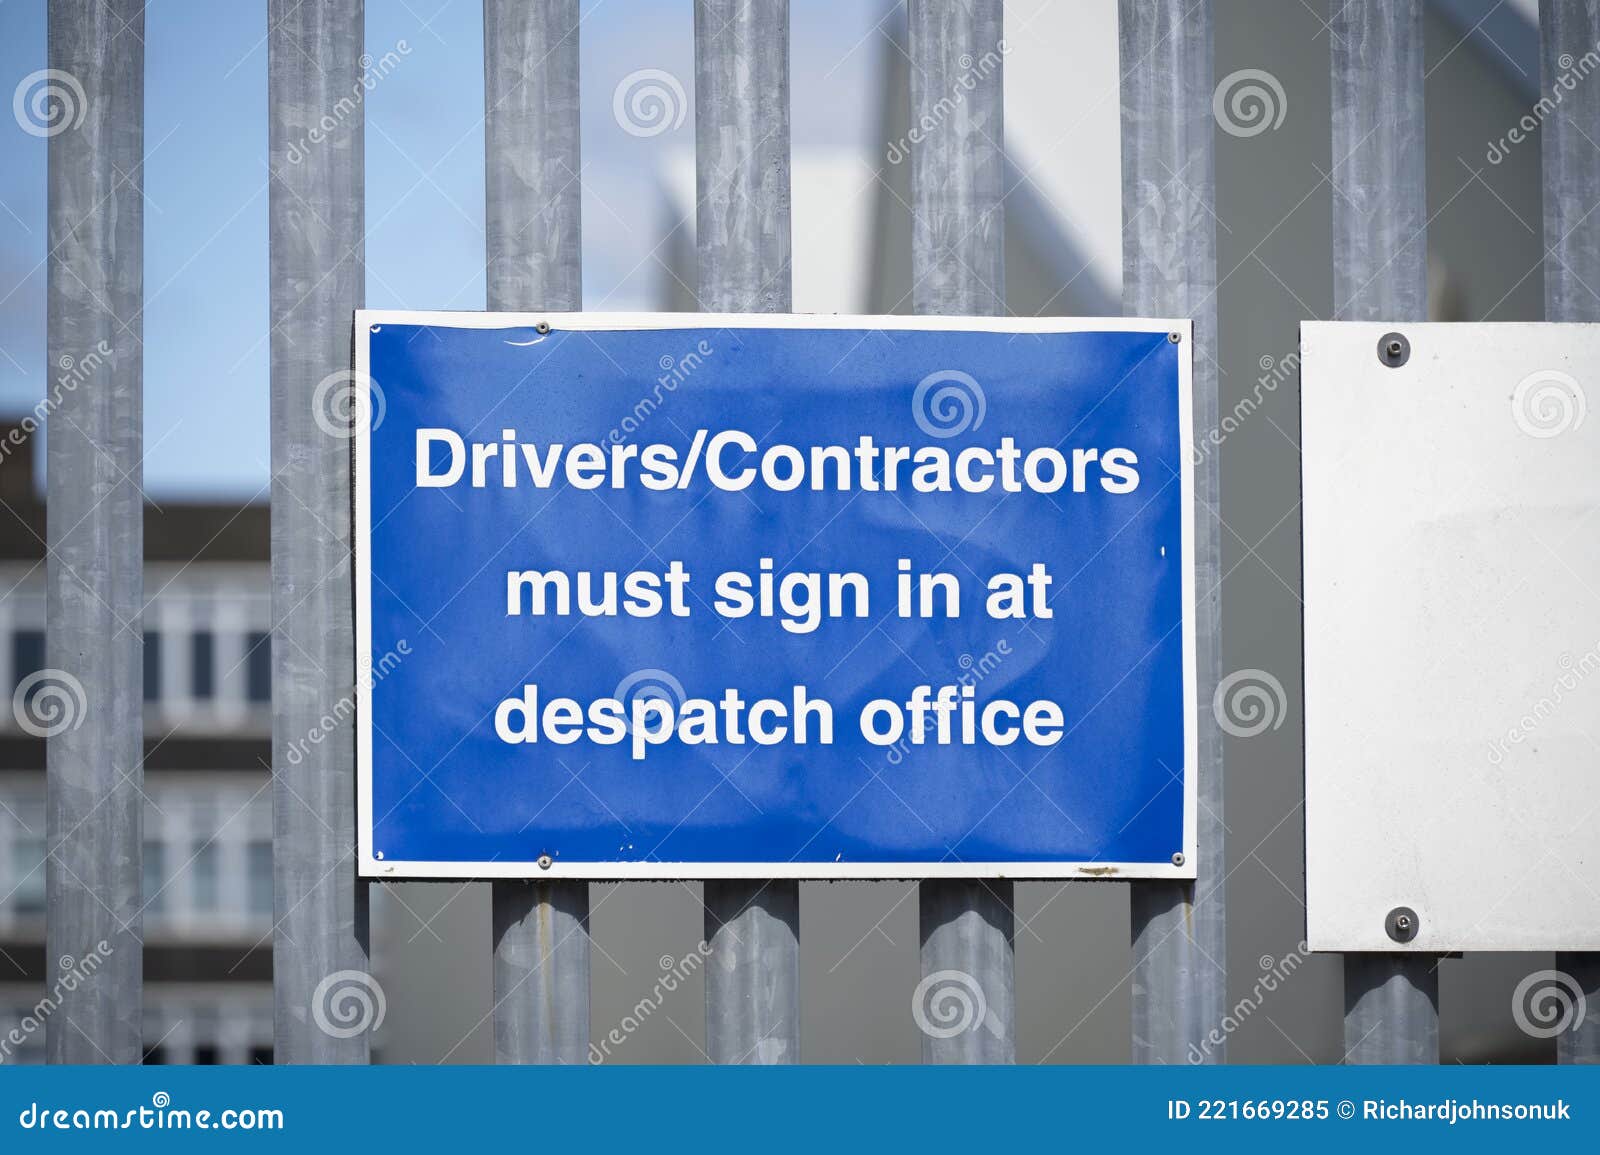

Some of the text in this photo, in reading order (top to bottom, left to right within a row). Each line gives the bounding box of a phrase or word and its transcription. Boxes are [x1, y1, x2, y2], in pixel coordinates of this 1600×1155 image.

[416, 428, 1140, 494] Drivers/Contractors
[507, 557, 1053, 634] must sign in at
[494, 684, 1064, 760] despatch office
